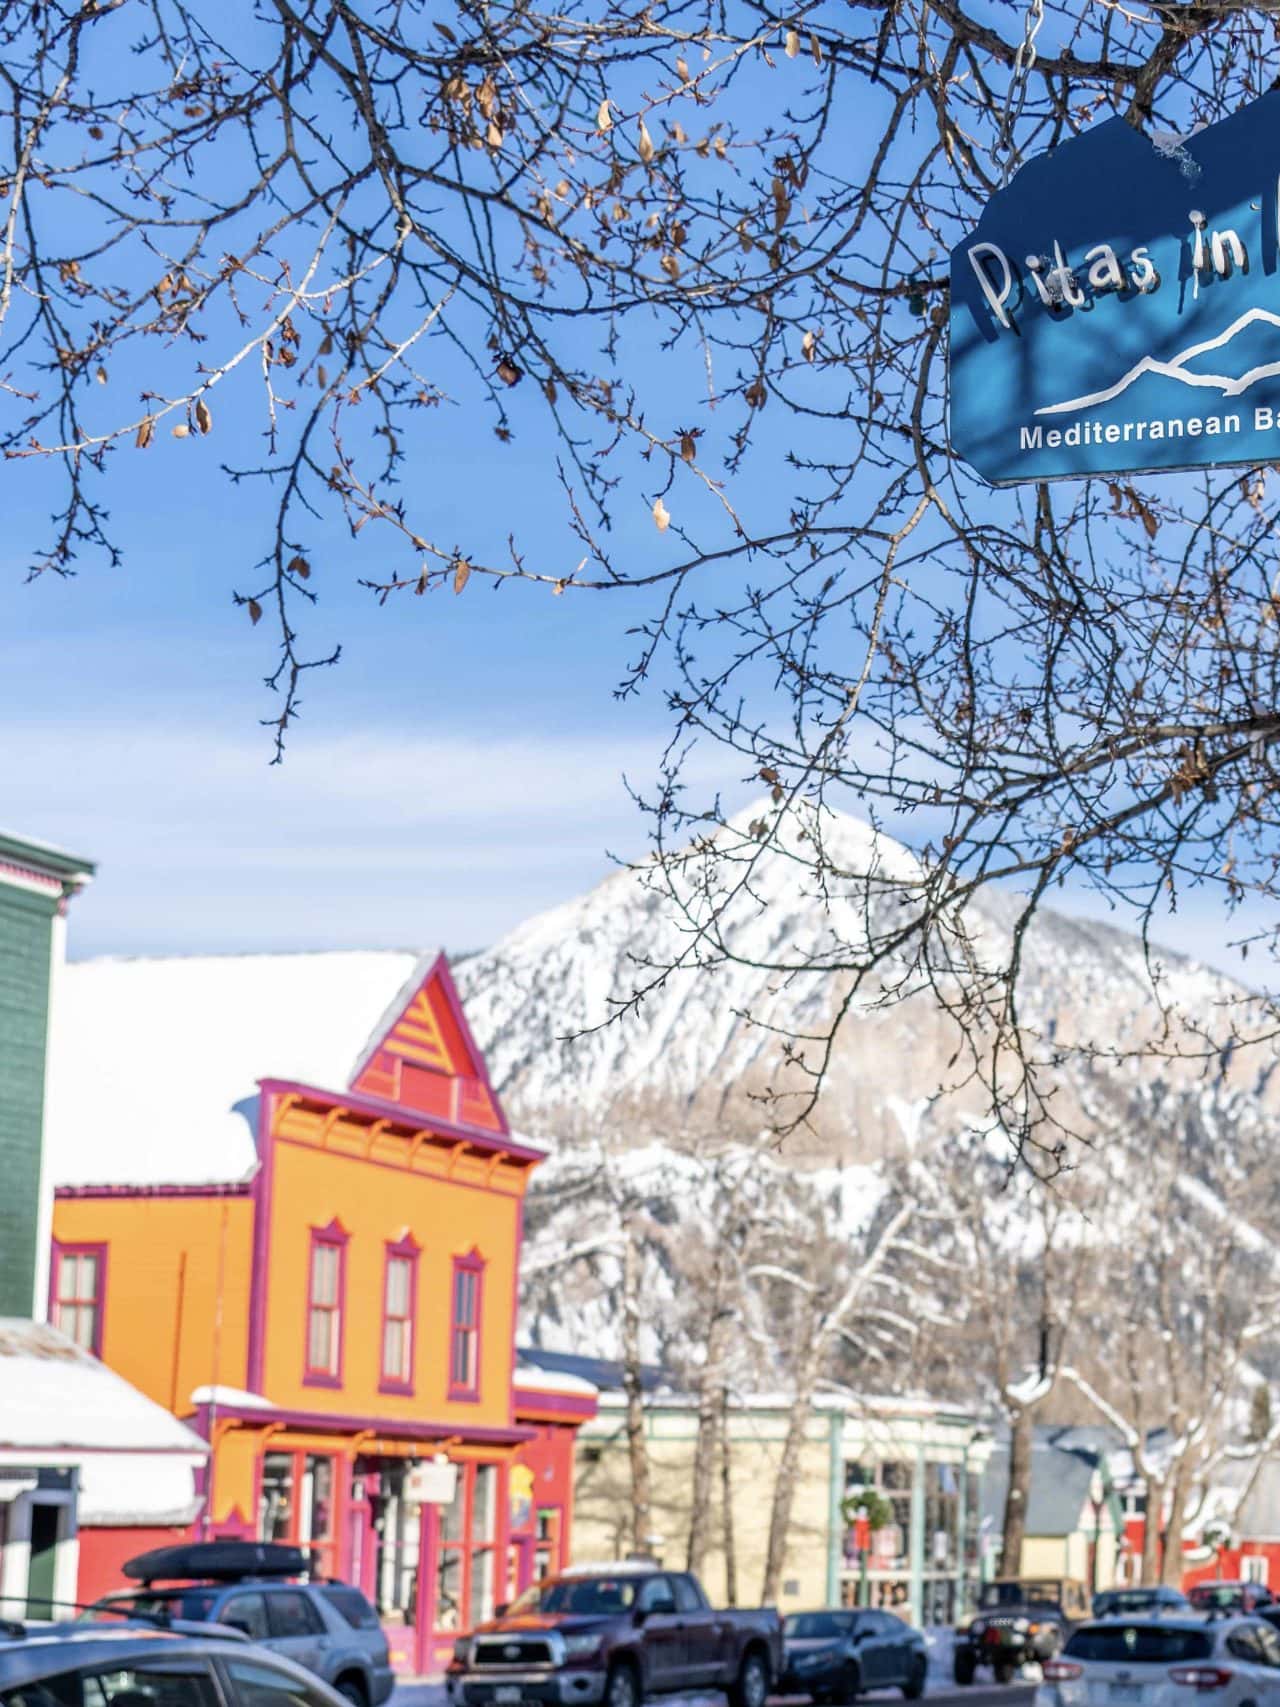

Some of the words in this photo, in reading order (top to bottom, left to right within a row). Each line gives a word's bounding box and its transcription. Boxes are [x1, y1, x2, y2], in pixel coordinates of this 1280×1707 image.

[968, 239, 1155, 328] Pitas
[1188, 209, 1244, 300] in
[1020, 413, 1240, 449] Mediterranean
